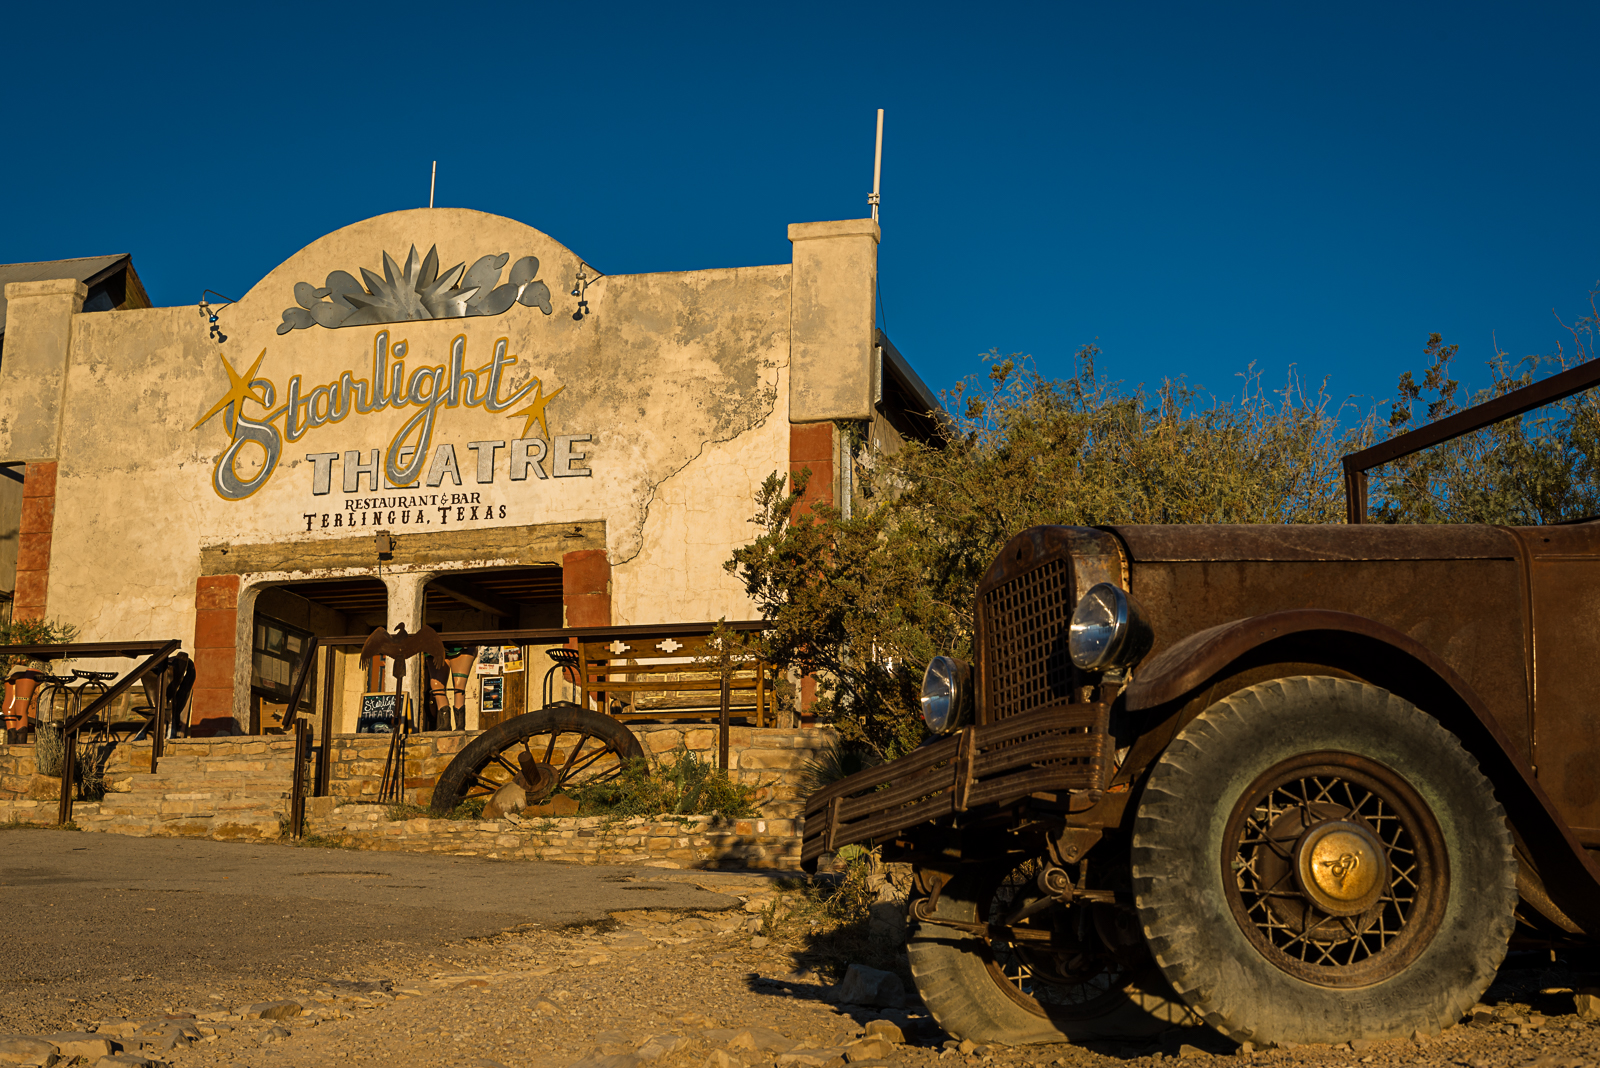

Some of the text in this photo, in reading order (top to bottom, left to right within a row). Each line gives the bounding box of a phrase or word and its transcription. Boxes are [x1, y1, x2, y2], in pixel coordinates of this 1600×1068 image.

[212, 329, 541, 502] Starlight
[344, 492, 481, 511] RESTAURANT & BAR
[303, 505, 507, 531] TERLINGUA, TEXAS
[364, 695, 397, 712] Starligh
[362, 709, 396, 719] THEATR
